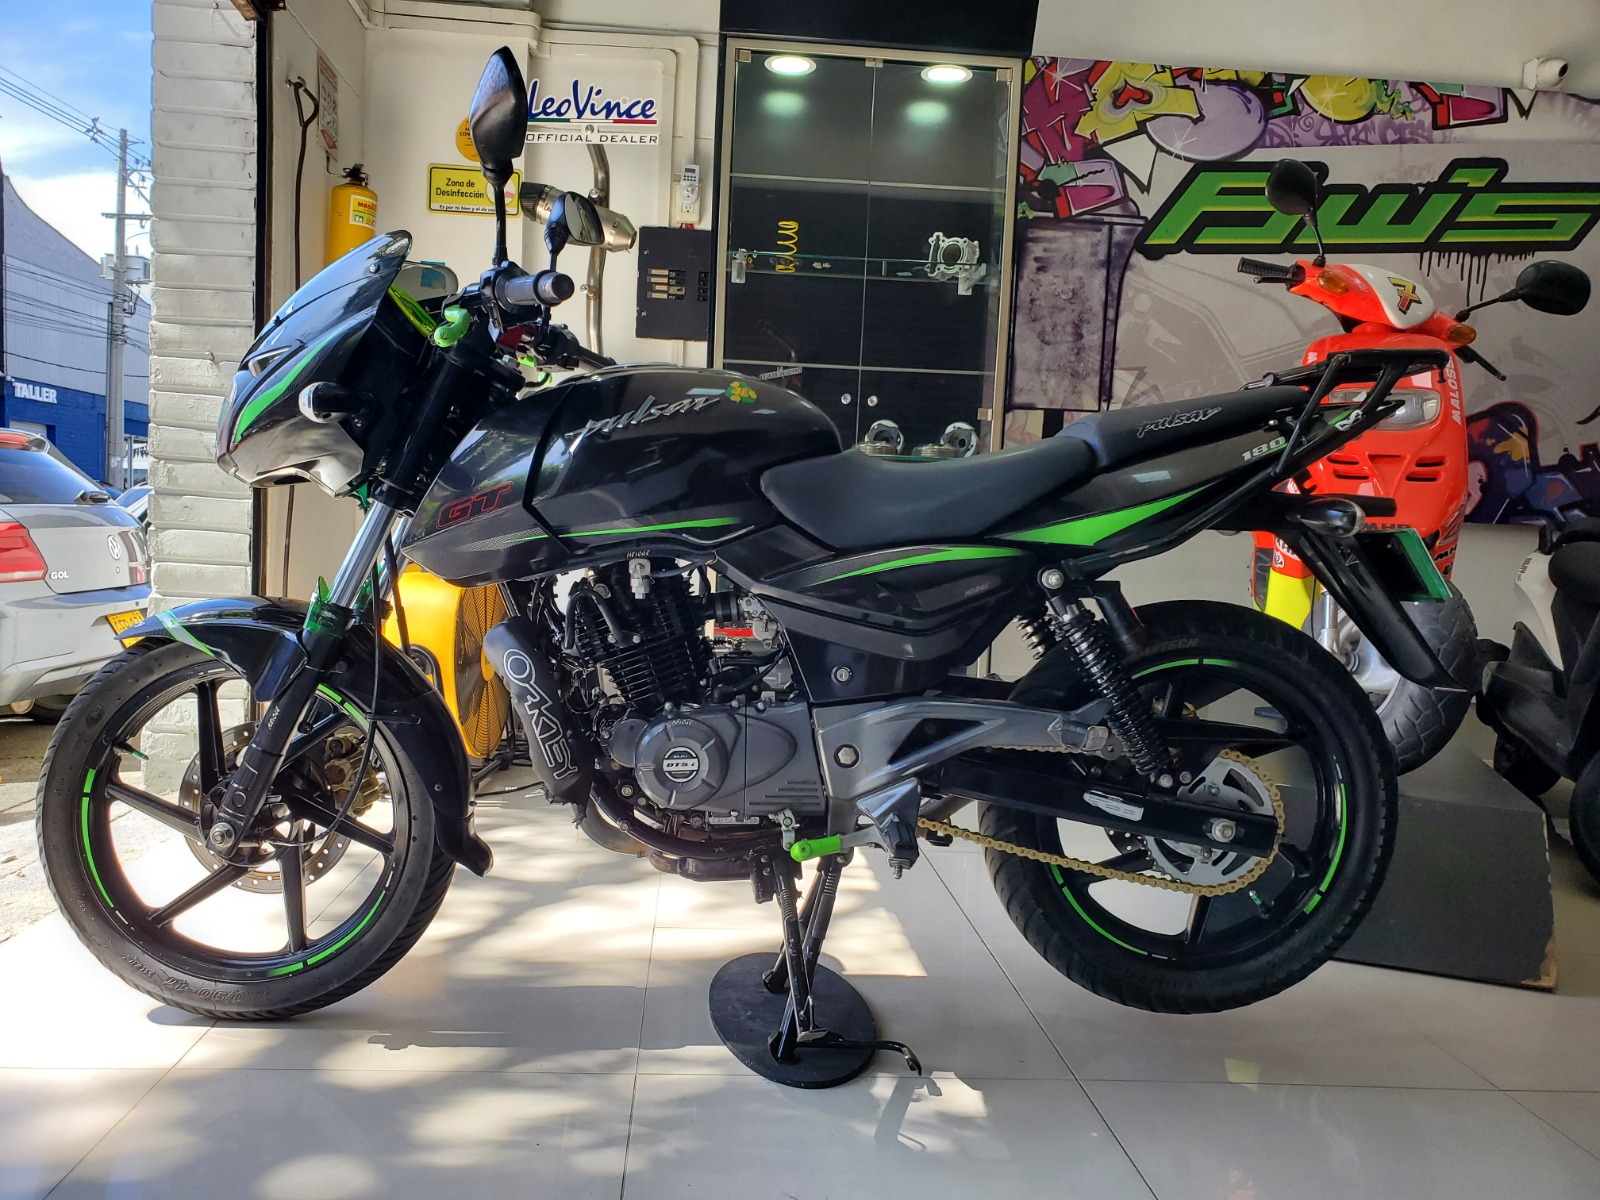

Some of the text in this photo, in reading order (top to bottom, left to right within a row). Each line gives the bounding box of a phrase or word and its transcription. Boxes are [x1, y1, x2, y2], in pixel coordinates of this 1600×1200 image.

[527, 79, 657, 119] LeoVince
[526, 133, 658, 144] OFFICIAL DEALER
[435, 187, 485, 199] Desinfección
[445, 177, 475, 188] Zona de
[14, 381, 58, 404] TALLER
[564, 394, 720, 459] pulsar
[1136, 406, 1222, 439] pulsar
[1241, 436, 1287, 462] 180
[436, 480, 514, 529] GT
[50, 571, 70, 580] GOL
